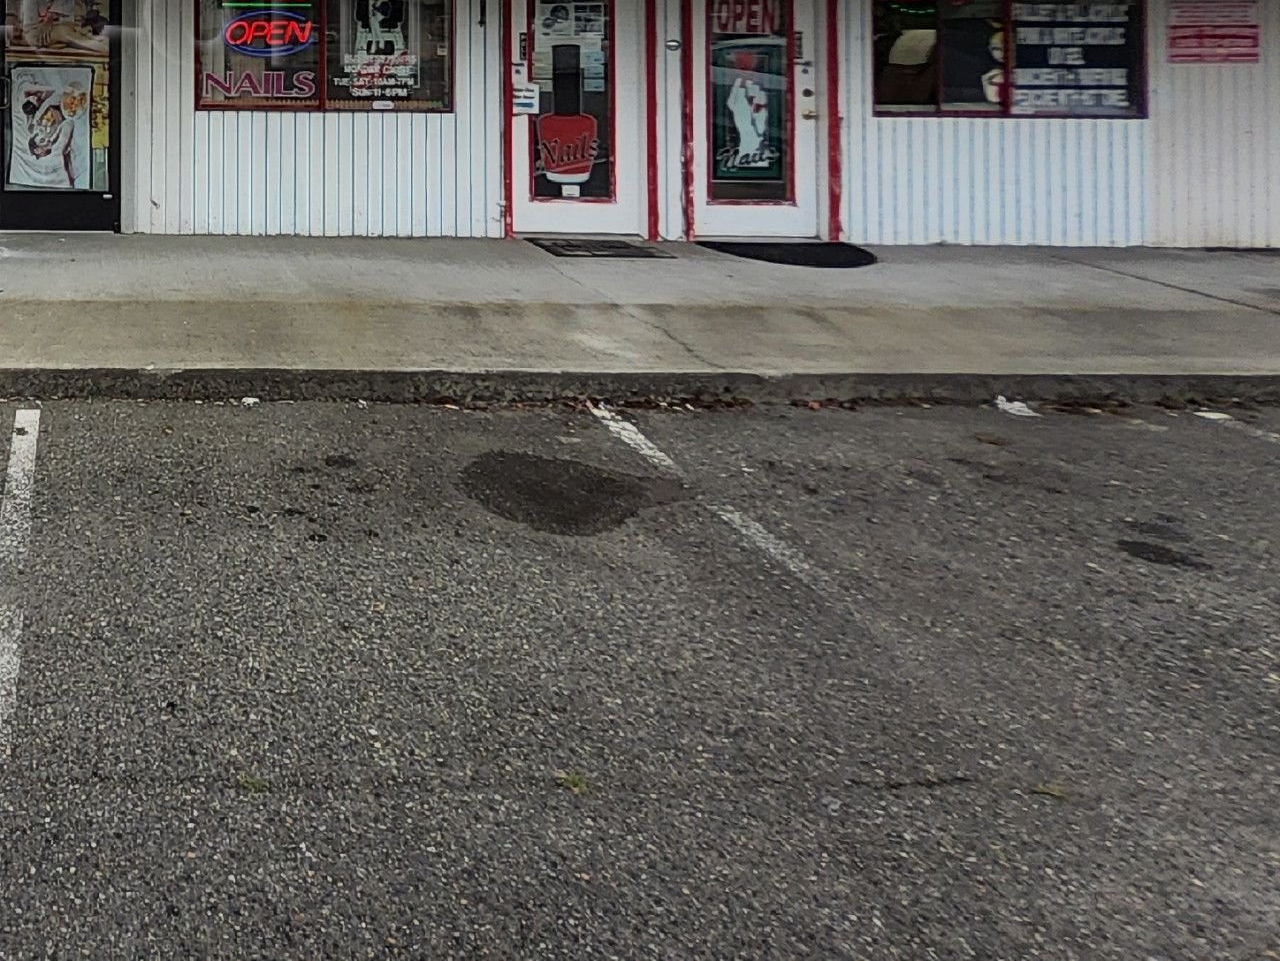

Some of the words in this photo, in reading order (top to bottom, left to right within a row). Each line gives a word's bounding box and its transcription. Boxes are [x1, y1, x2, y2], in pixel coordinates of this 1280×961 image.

[225, 20, 312, 45] OPEN
[202, 71, 316, 98] NAILS
[539, 133, 600, 168] Nails
[716, 144, 780, 172] Nails
